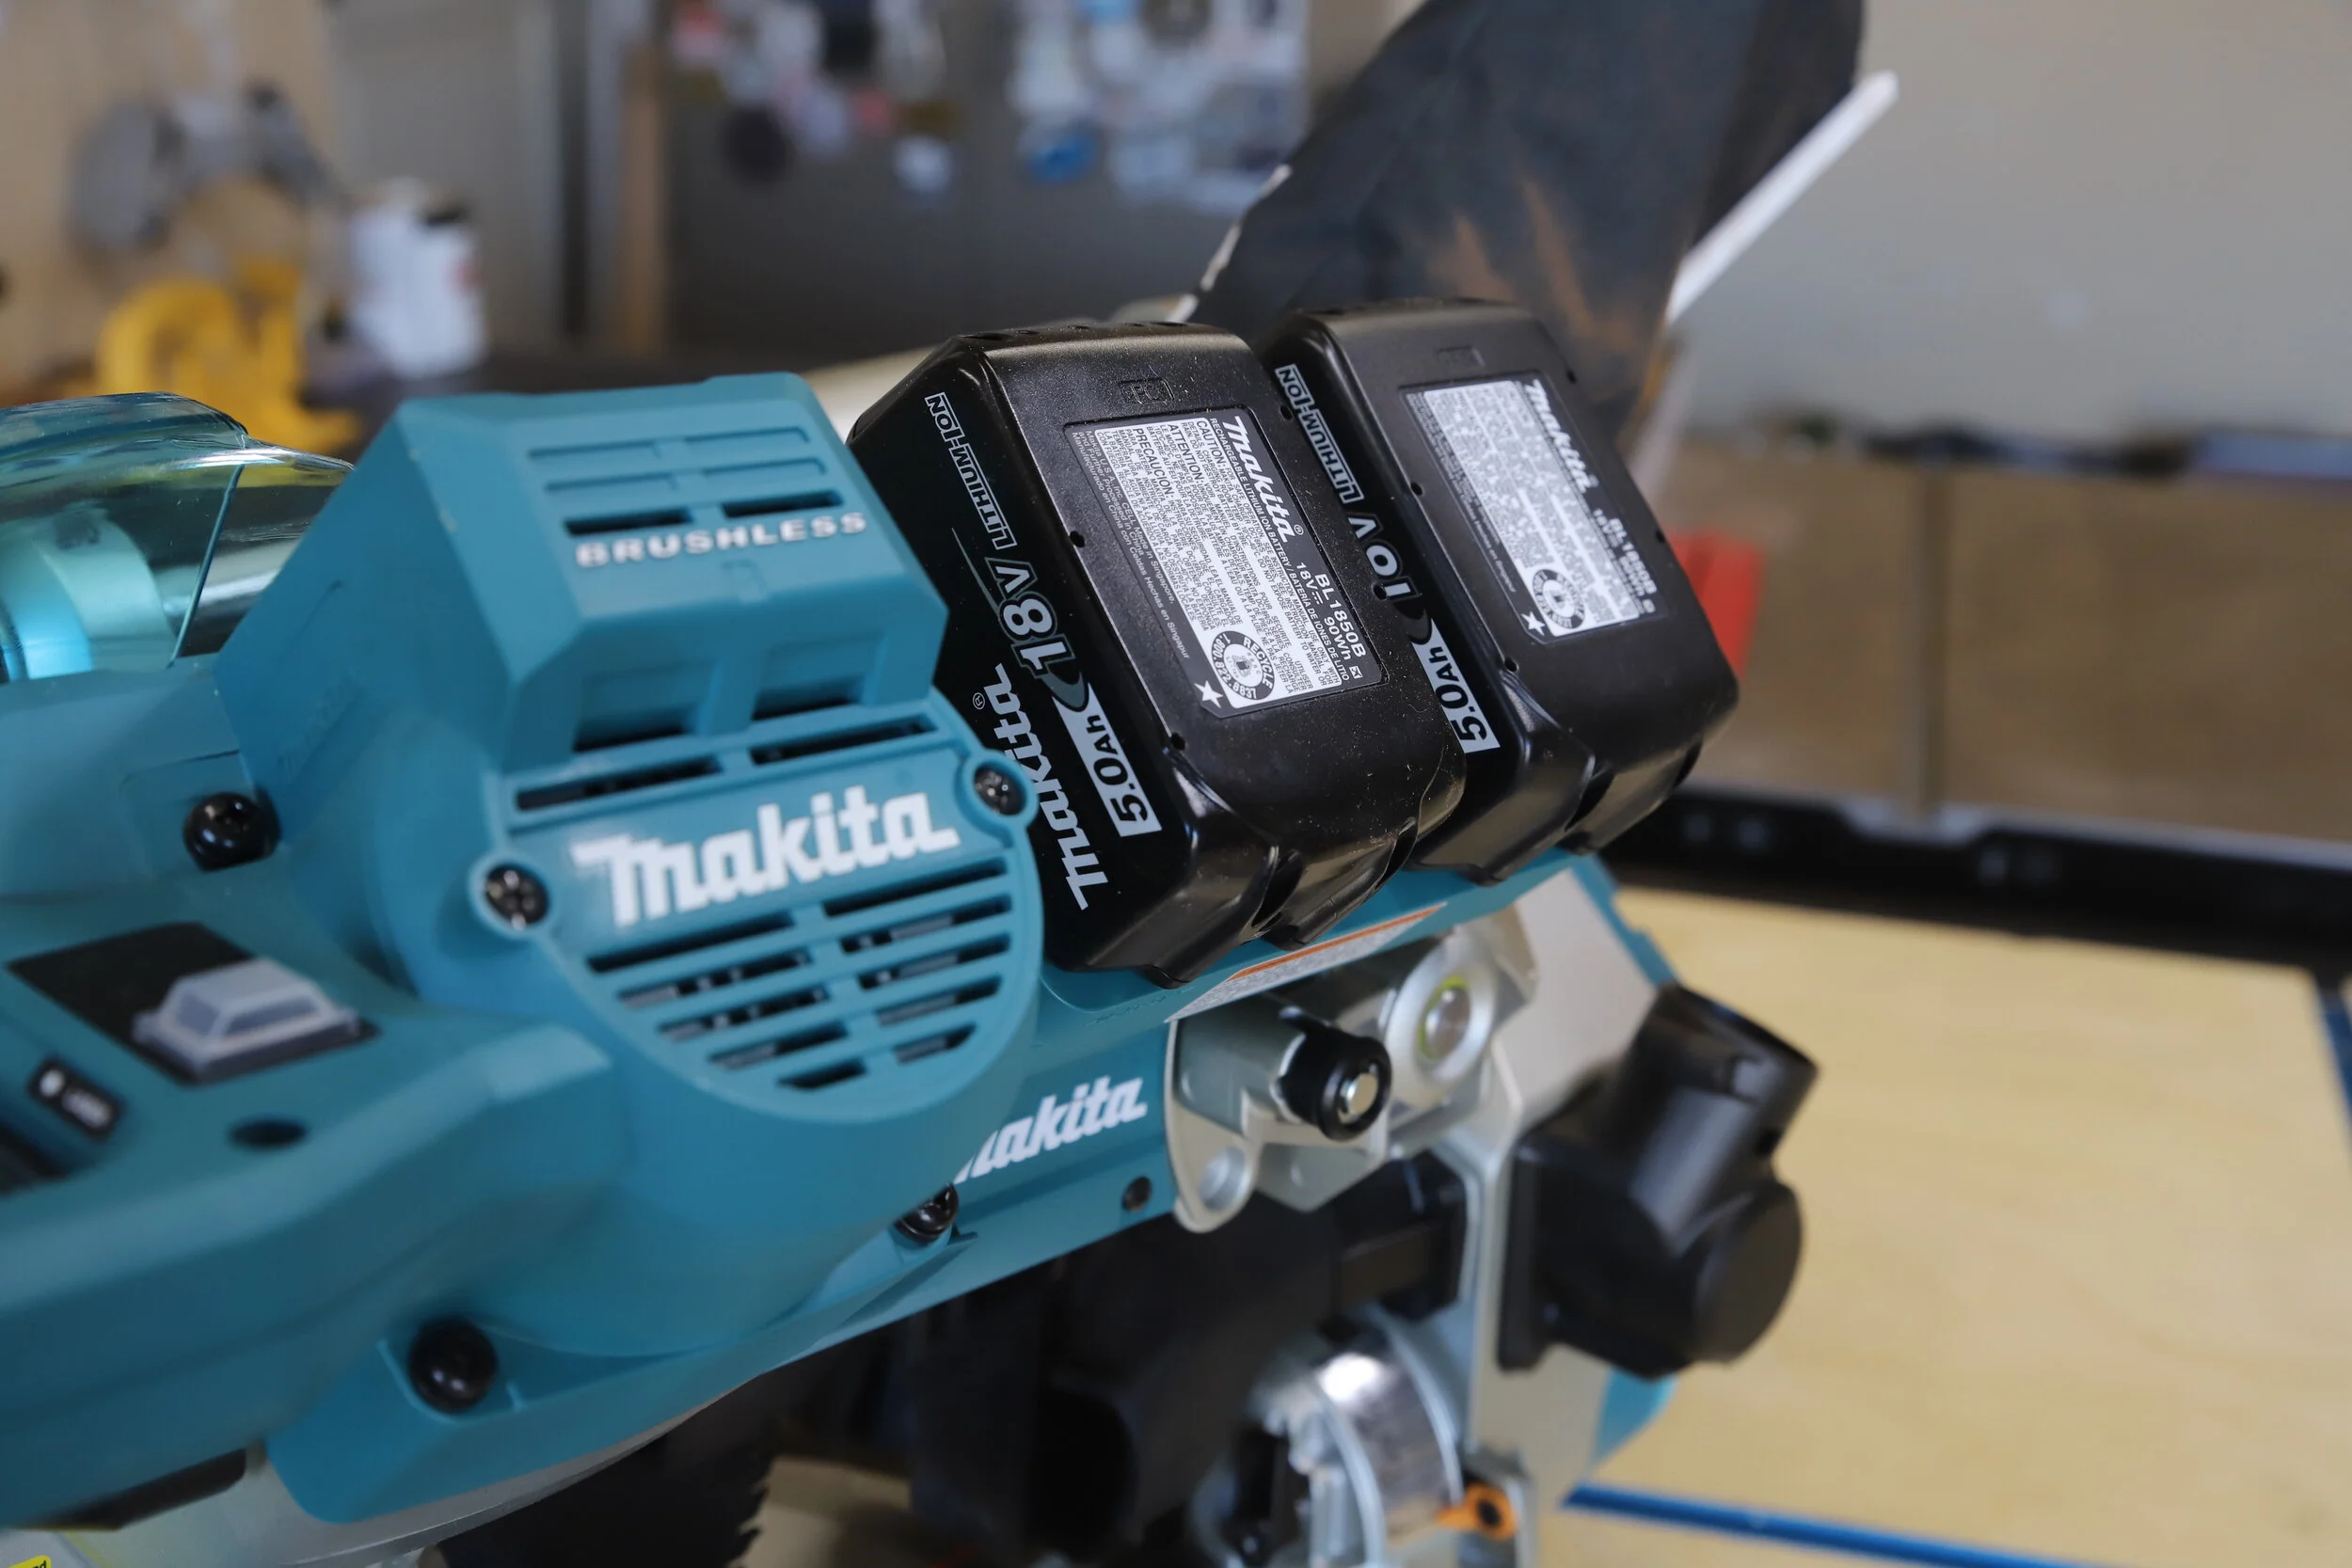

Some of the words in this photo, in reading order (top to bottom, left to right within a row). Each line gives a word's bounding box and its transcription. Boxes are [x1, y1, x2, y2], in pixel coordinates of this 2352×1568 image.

[924, 392, 1018, 549] LITHIUM-ION
[1131, 427, 1180, 498] PRECAUCIÓN:
[1167, 423, 1207, 483] ATTENTION:
[1195, 420, 1228, 467] CAUTION:
[1275, 363, 1365, 504] LITHIUM-ION
[575, 512, 866, 568] BRUSHLESS
[1209, 418, 1248, 482] RECHARGEABLE
[1242, 483, 1264, 515] LITHIUM
[1259, 515, 1272, 531] ION
[1266, 531, 1291, 566] BATTERY
[1288, 572, 1313, 607] BATERÍA
[1306, 608, 1317, 619] DE
[1312, 621, 1331, 645] IONES
[1326, 646, 1338, 658] DE
[1332, 659, 1349, 681] LITIO
[986, 559, 1074, 678] 18V
[1295, 562, 1318, 591] 18V
[1322, 616, 1354, 660] 90Wh
[1313, 573, 1367, 657] BL1850B
[1244, 636, 1273, 688] RECYCLE
[1428, 644, 1487, 741] 5.0Ah
[983, 662, 1109, 911] makita
[1084, 711, 1150, 822] 5.0Ah
[568, 784, 961, 927] makita
